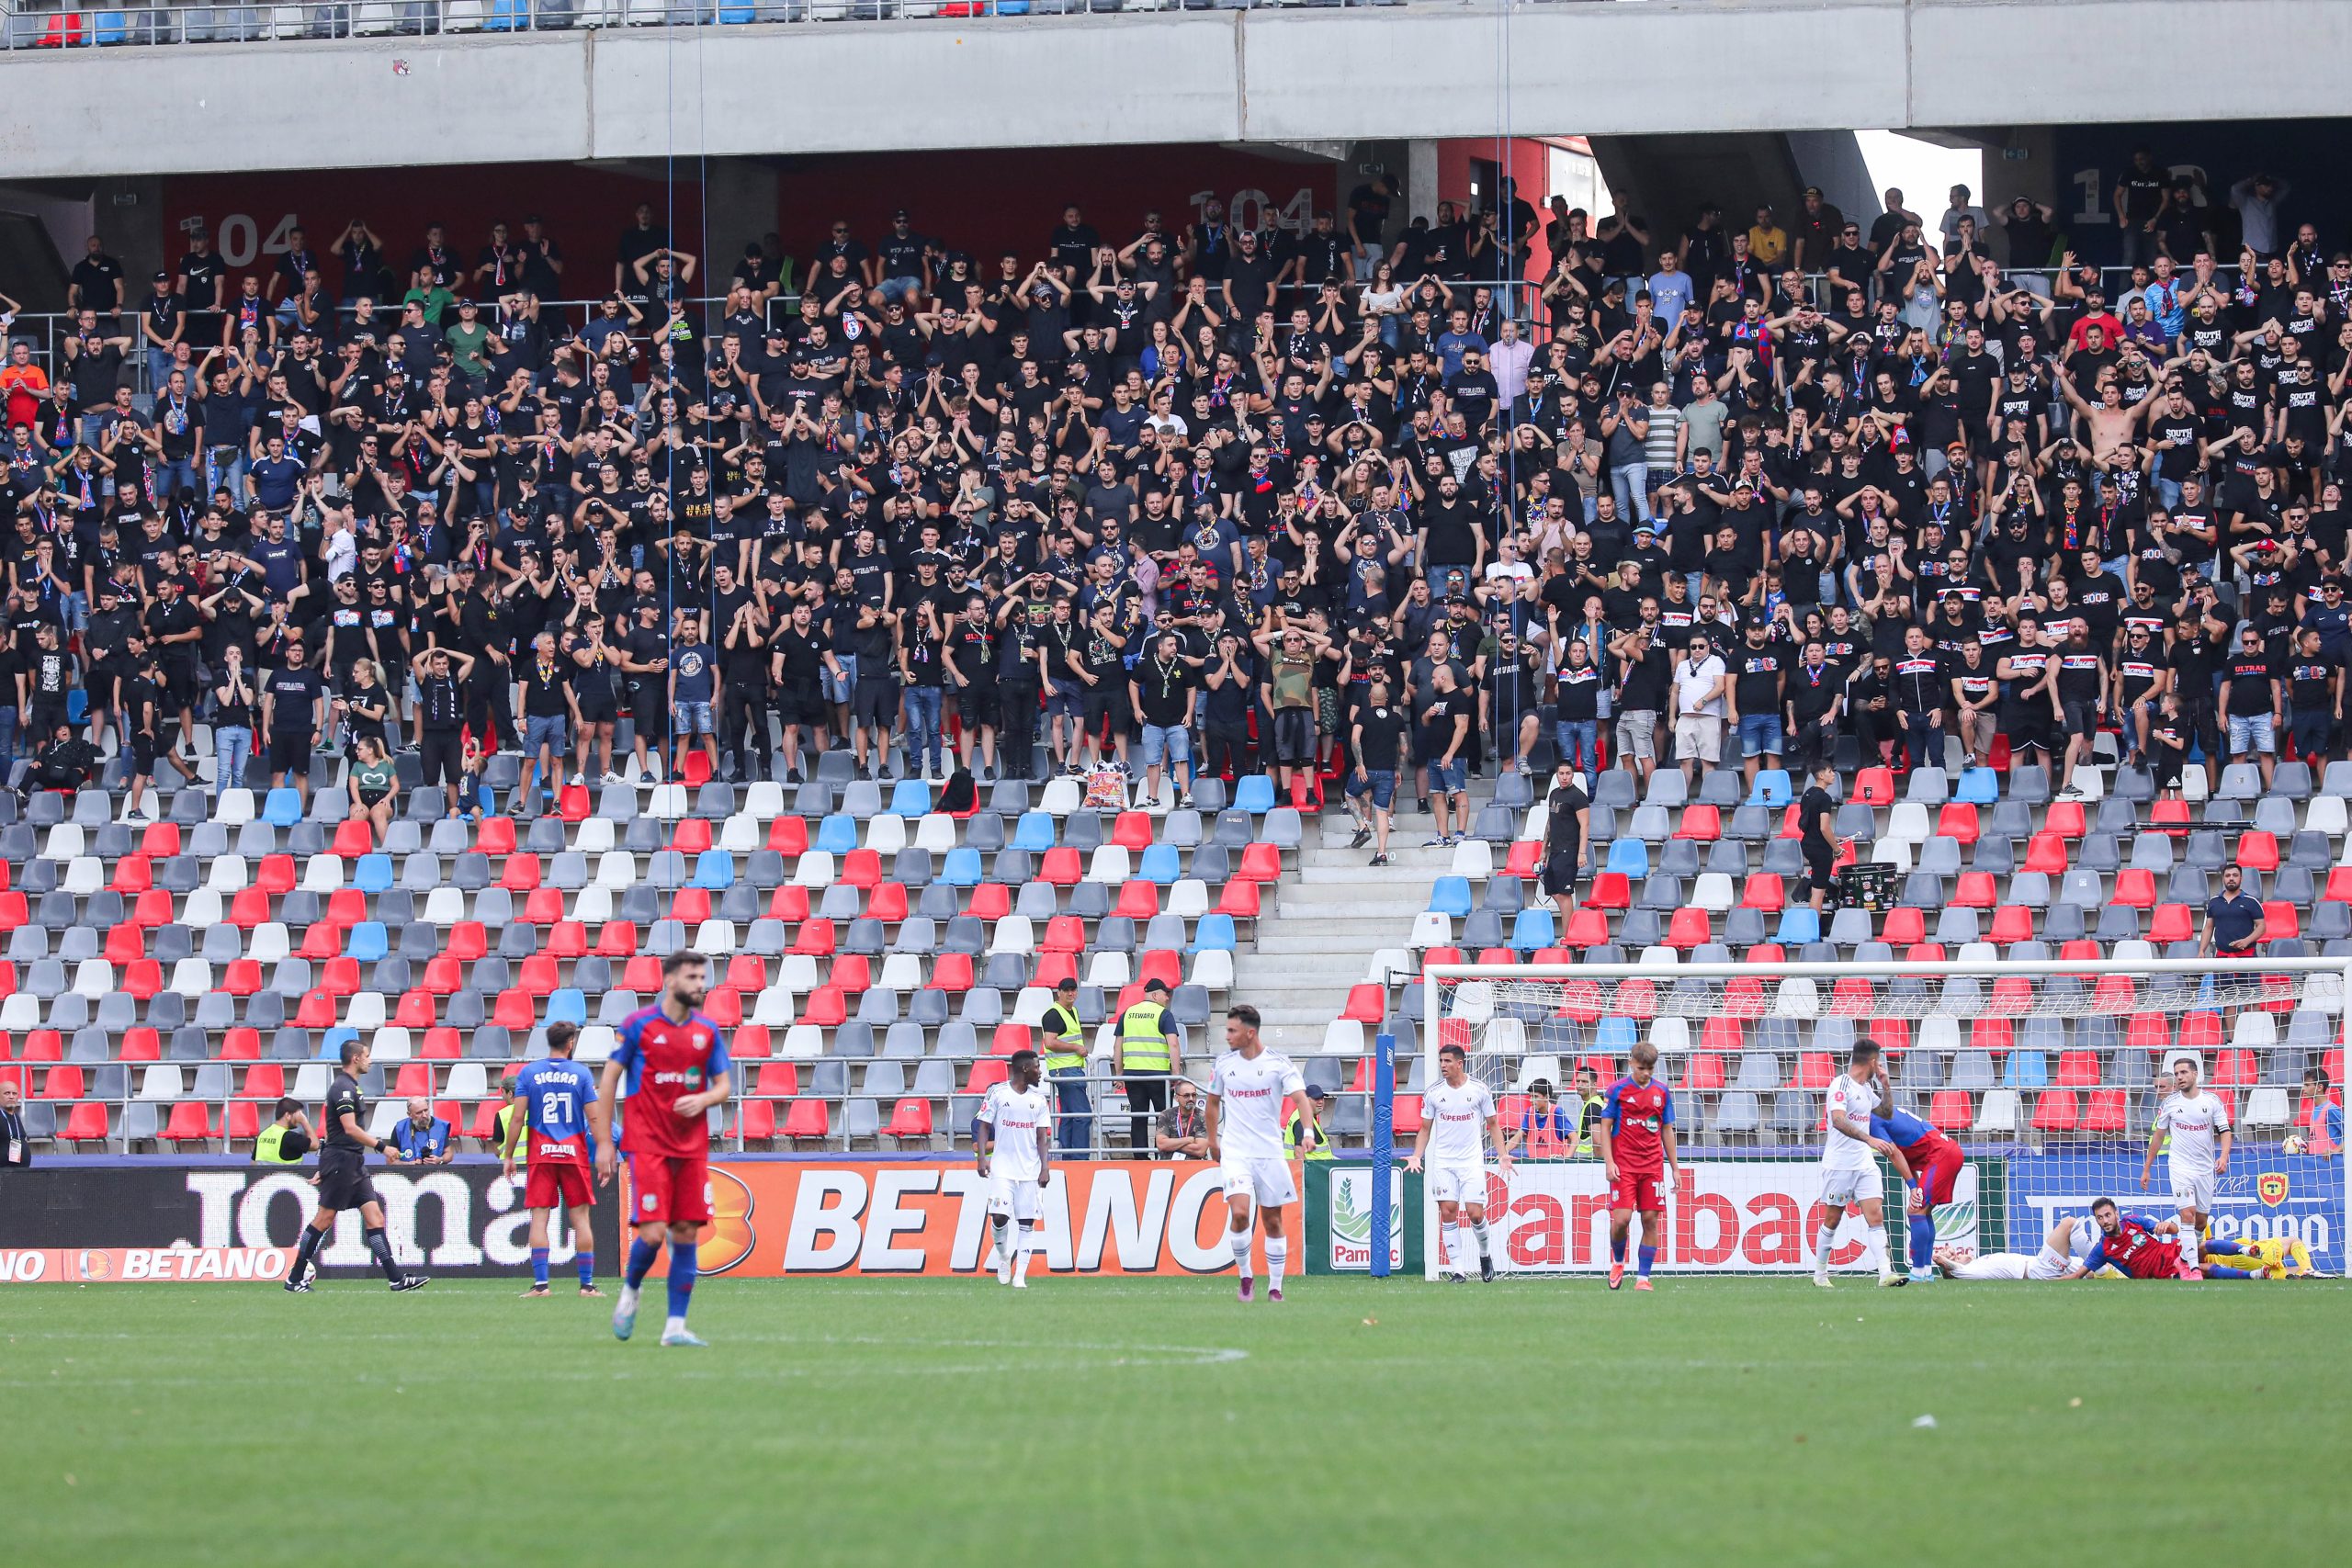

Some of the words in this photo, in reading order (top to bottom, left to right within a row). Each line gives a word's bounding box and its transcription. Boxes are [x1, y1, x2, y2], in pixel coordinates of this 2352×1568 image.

[2290, 318, 2314, 329] SOUTH
[2194, 330, 2222, 341] SOUTH
[2278, 370, 2298, 379] SOUT
[2233, 391, 2256, 403] SOUTH
[2290, 391, 2315, 402] SOUTH
[2004, 400, 2029, 412] SOUTH
[2166, 428, 2192, 439] SOUTH
[2047, 624, 2068, 634] Vacar
[1493, 664, 1521, 676] SAVAGE
[1275, 1028, 1283, 1037] 5
[534, 1071, 579, 1087] SIERRA
[542, 1092, 574, 1124] 27
[1439, 1111, 1476, 1122] SUPERBET
[540, 1144, 576, 1157] STEAUA
[1335, 1245, 1399, 1263] Pamc
[122, 1249, 287, 1280] BETANO
